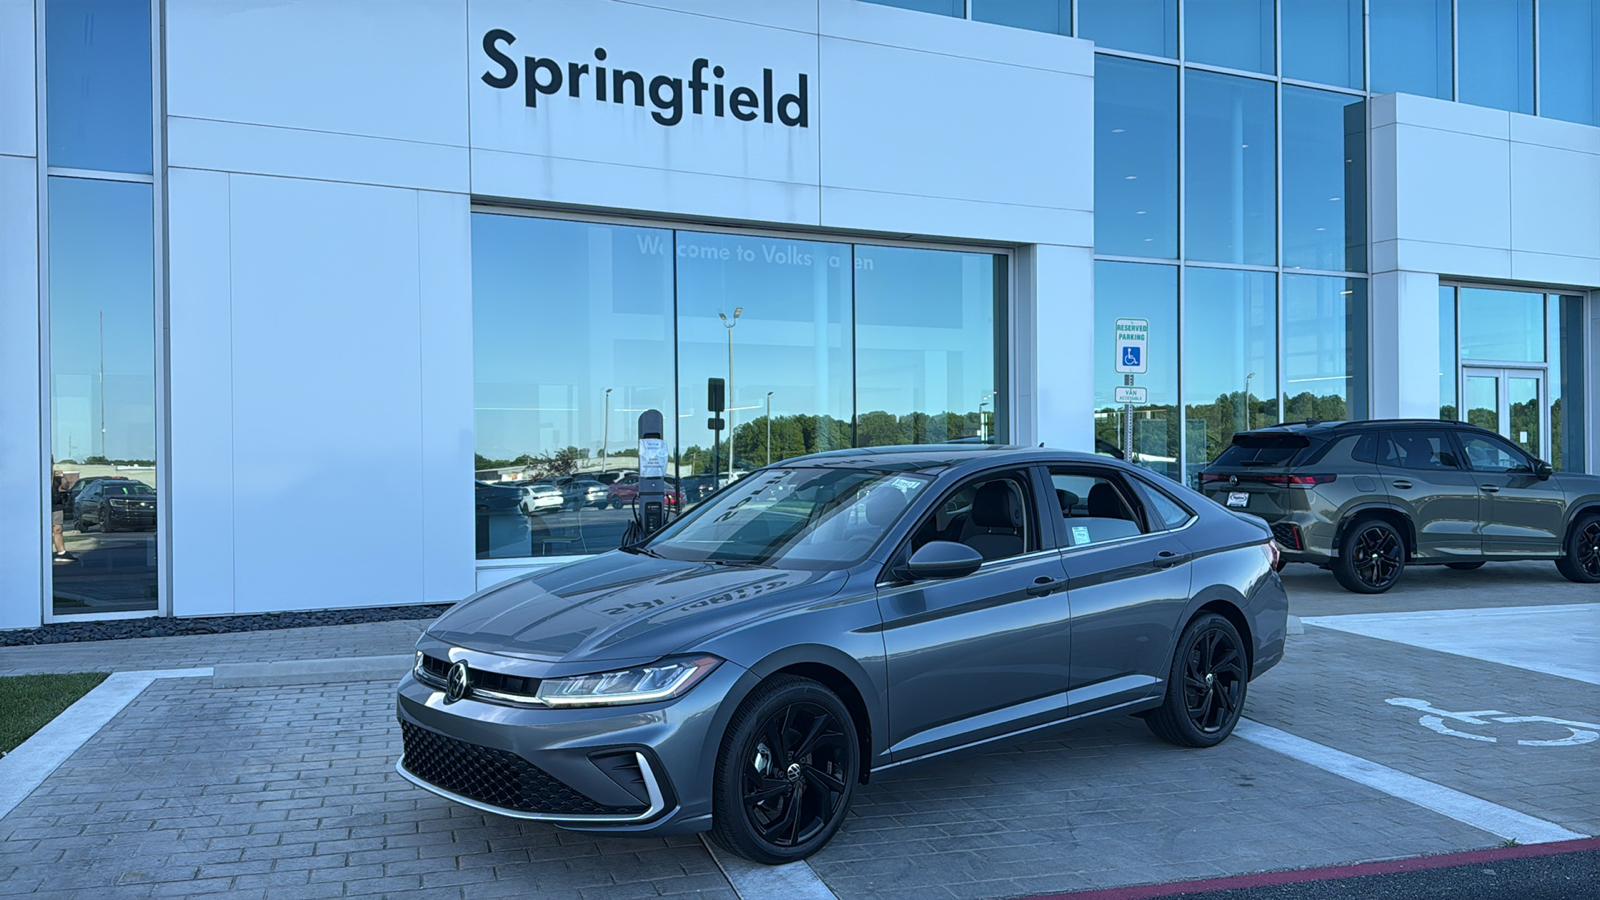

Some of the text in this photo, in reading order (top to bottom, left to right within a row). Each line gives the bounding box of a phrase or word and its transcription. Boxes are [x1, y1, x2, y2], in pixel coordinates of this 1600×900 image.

[481, 28, 809, 128] Springfield
[637, 234, 731, 261] Wcome
[736, 245, 755, 262] to
[1117, 324, 1147, 332] RESERVED
